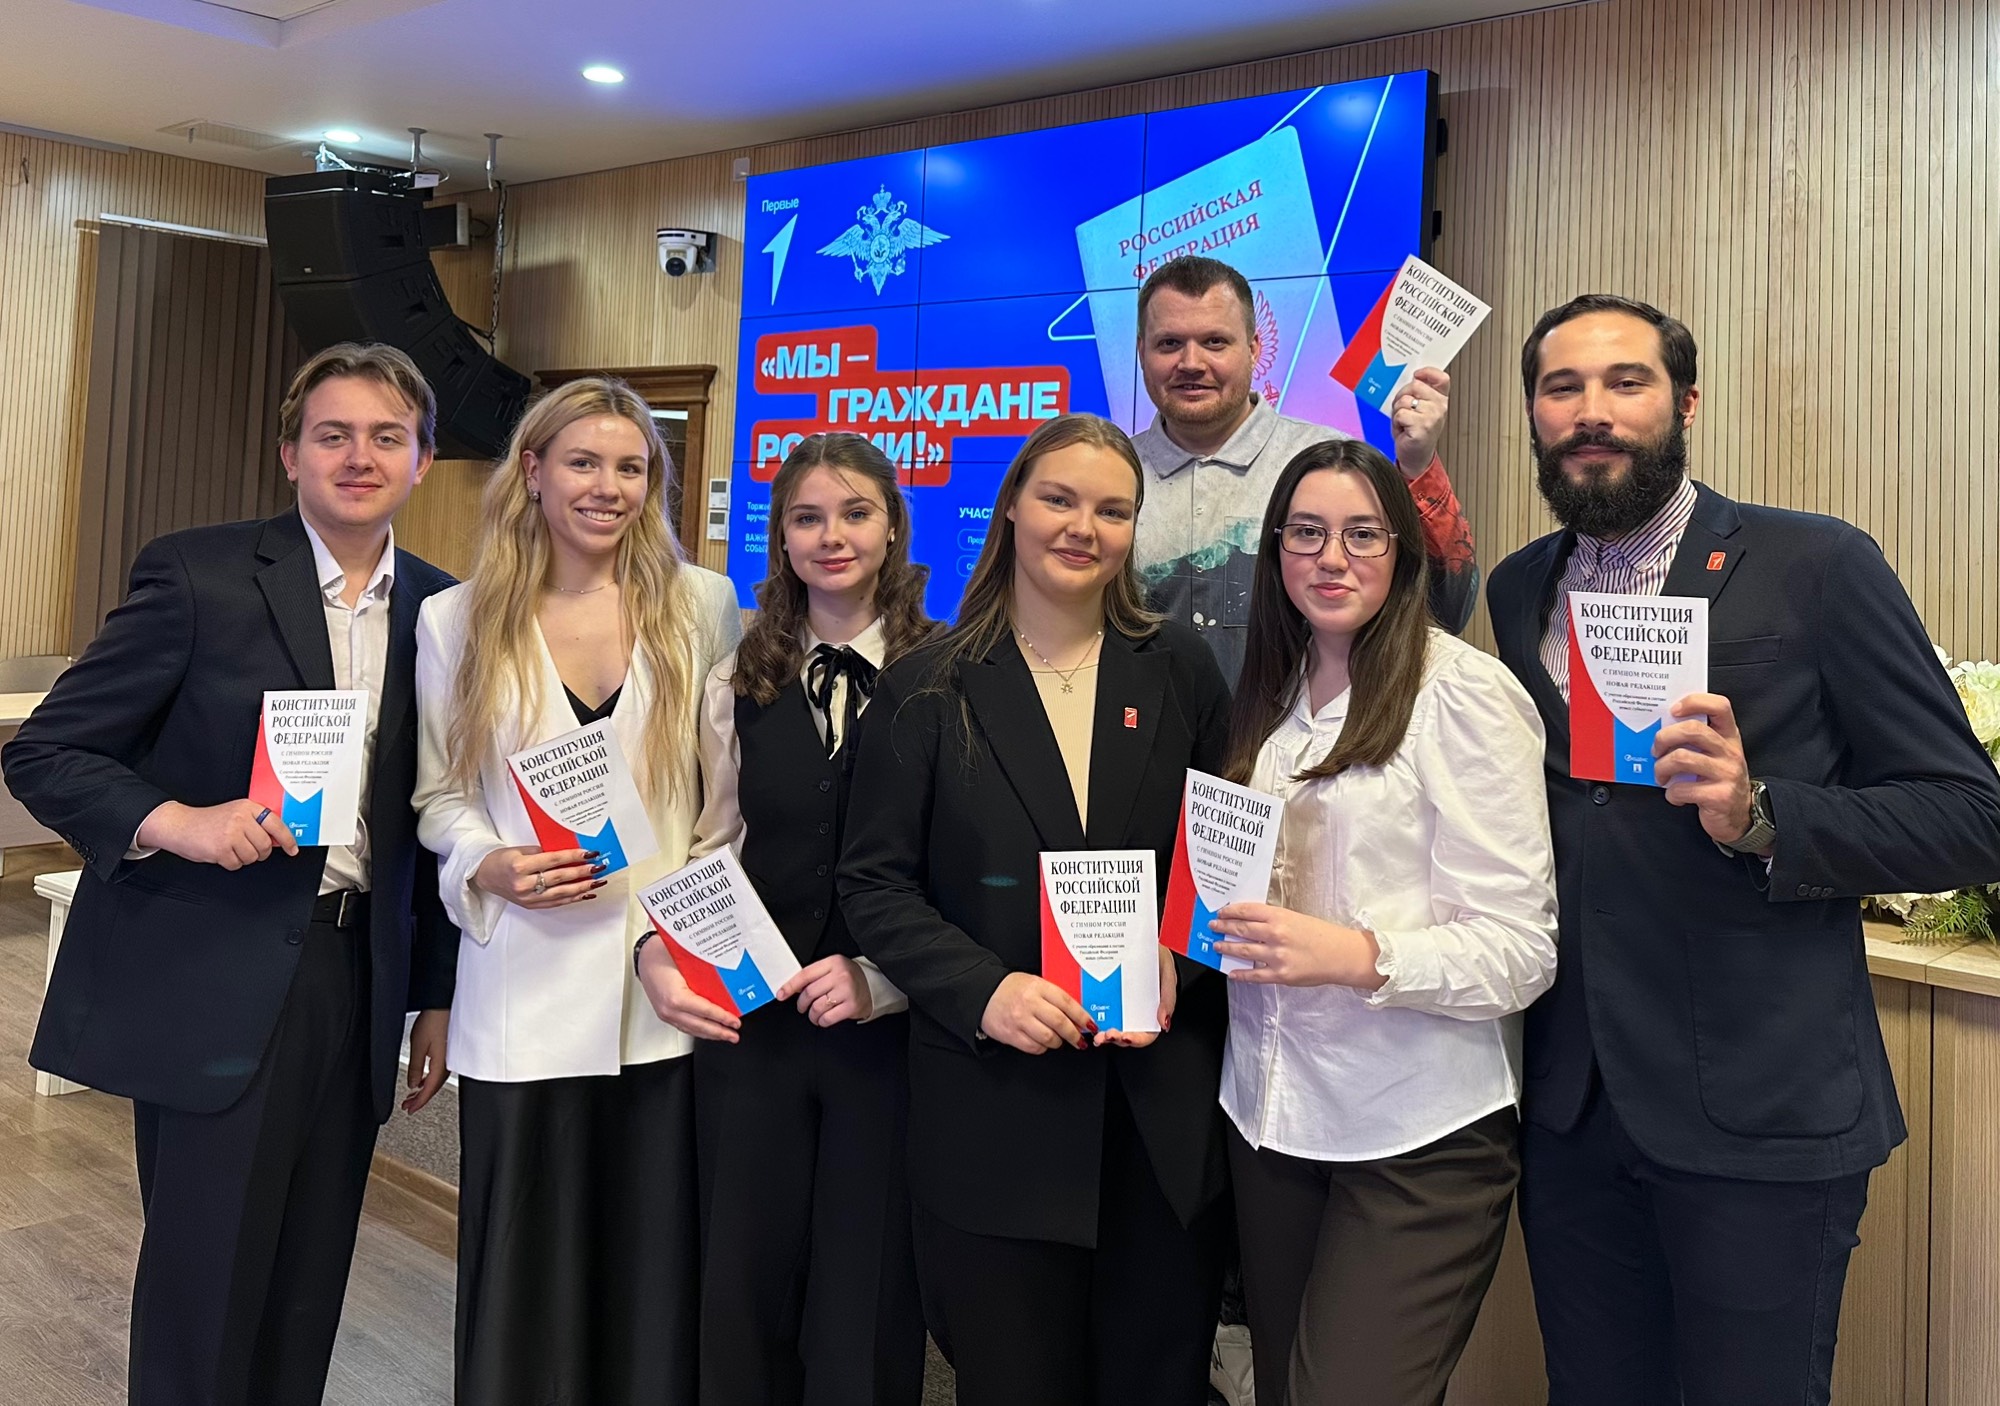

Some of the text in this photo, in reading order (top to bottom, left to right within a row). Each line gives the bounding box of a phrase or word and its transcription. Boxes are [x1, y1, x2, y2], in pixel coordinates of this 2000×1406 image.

[761, 197, 799, 215] Первые
[1118, 179, 1263, 258] РОССИЙСКАЯ
[1399, 280, 1465, 327] РОССИЙСКОЙ
[1406, 264, 1477, 316] КОНСТИТУЦИЯ
[1394, 296, 1451, 338] ФЕДЕРАЦИИ
[761, 343, 841, 379] «МЫ
[828, 381, 1060, 428] ГРАЖДАНЕ
[1581, 602, 1693, 624] КОНСТИТУЦИЯ
[1585, 624, 1688, 645] РОССИЙСКОЙ
[1590, 645, 1682, 666] ФЕДЕРАЦИИ
[271, 699, 356, 711] КОНСТИТУЦИЯ
[1630, 683, 1666, 691] РЕДАКЦИЯ
[272, 713, 351, 728] РОССИЙСКОЙ
[274, 732, 344, 746] ФЕДЕРАЦИИ
[519, 730, 605, 773] КОНСТИТУЦИЯ
[529, 745, 608, 786] РОССИЙСКОЙ
[539, 763, 609, 799] ФЕДЕРАЦИИ
[1191, 780, 1272, 820] КОНСТИТУЦИЯ
[1191, 801, 1264, 839] РОССИЙСКОЙ
[1192, 821, 1256, 857] ФЕДЕРАЦИИ
[647, 859, 726, 907] КОНСТИТУЦИЯ
[1051, 860, 1143, 875] КОНСТИТУЦИЯ
[1055, 876, 1140, 895] РОССИЙСКОЙ
[659, 874, 732, 920] РОССИЙСКОЙ
[672, 893, 737, 932] ФЕДЕРАЦИИ
[1060, 899, 1136, 915] ФЕДЕРАЦИИ
